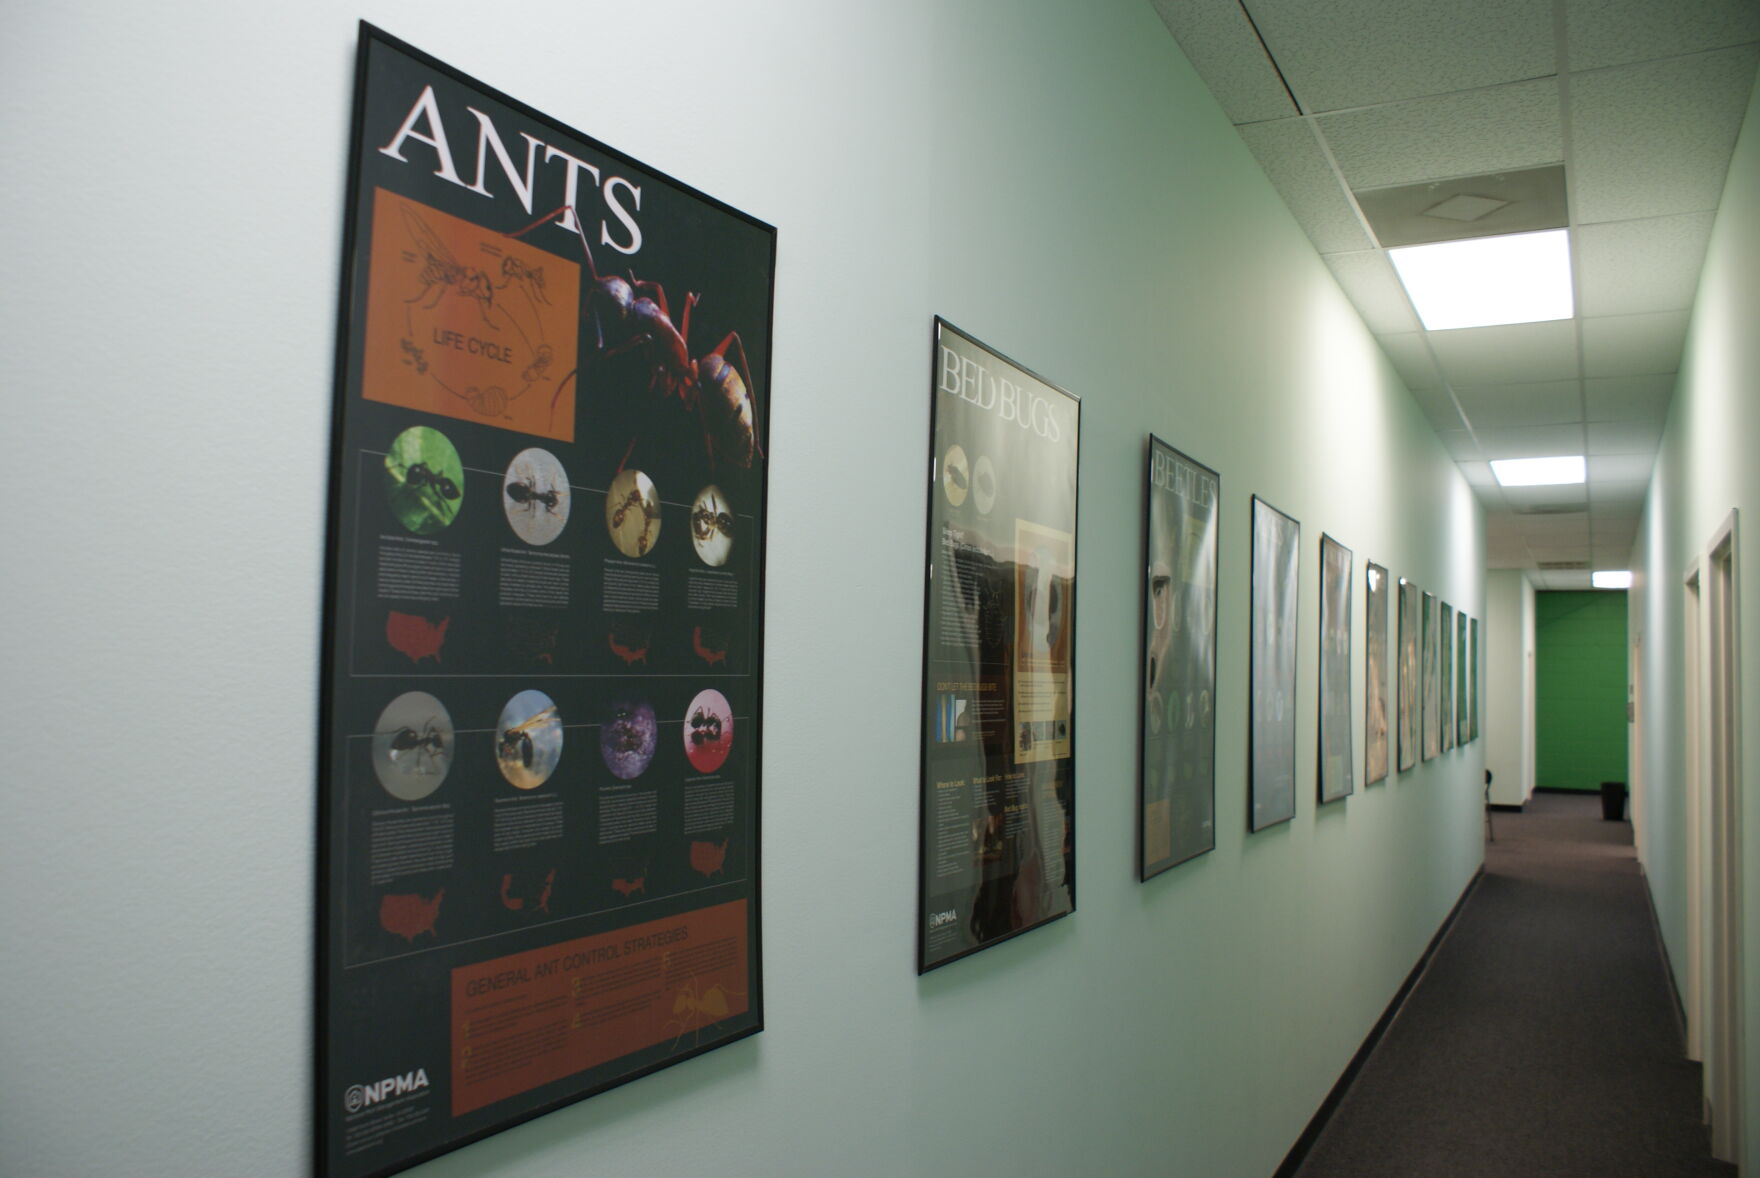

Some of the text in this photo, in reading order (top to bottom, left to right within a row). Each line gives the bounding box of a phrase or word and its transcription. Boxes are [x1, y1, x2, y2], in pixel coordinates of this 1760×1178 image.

[377, 85, 643, 255] ANTS
[432, 328, 513, 364] LIFE CYCLE
[939, 345, 1061, 443] BED BUGS
[935, 909, 957, 927] NPMA
[464, 925, 689, 998] GENERAL ANT CONTROL STRATEGIES
[364, 1068, 430, 1107] NPMA
